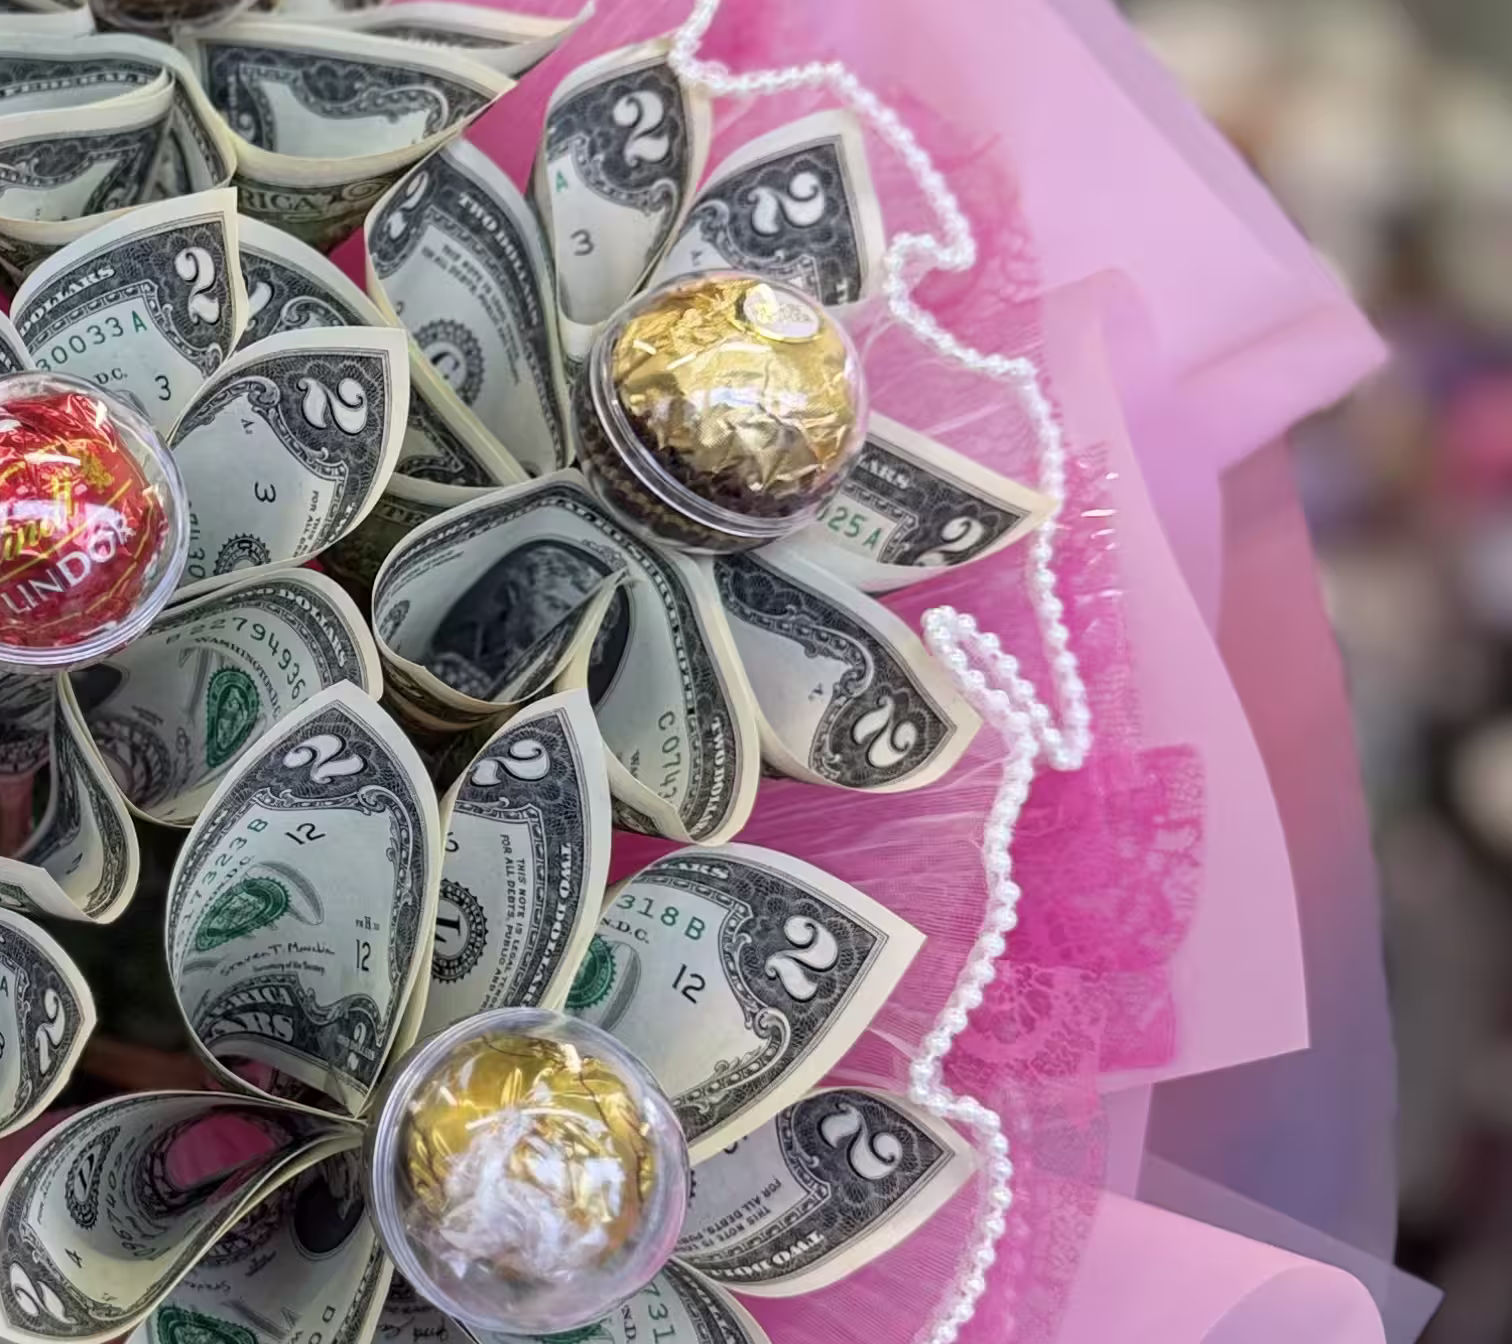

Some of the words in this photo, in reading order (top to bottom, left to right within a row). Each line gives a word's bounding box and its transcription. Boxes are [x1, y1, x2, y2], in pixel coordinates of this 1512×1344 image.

[612, 90, 671, 166] 2
[746, 170, 826, 236] 2
[569, 228, 595, 256] 3
[19, 265, 117, 338] DOLLARS
[174, 246, 221, 326] 2
[154, 374, 173, 402] 3
[295, 376, 369, 436] 2
[253, 480, 277, 505] 3
[850, 694, 919, 768] 2
[283, 733, 369, 785] 2
[470, 739, 550, 787] 2
[286, 821, 328, 846] 12
[500, 833, 513, 856] FOR
[505, 856, 515, 878] ALL
[516, 857, 527, 886] THIS
[559, 842, 572, 899] TWO
[517, 887, 527, 921] NOTE
[355, 939, 372, 973] 12
[499, 923, 514, 967] PUBLIC
[764, 914, 840, 1003] 2
[671, 964, 707, 1004] 12
[34, 987, 66, 1073] 2
[818, 1102, 904, 1181] 2
[741, 1195, 762, 1212] ALL
[760, 1178, 783, 1199] FOR
[771, 1229, 825, 1266] TWO
[8, 1259, 77, 1325] 2
